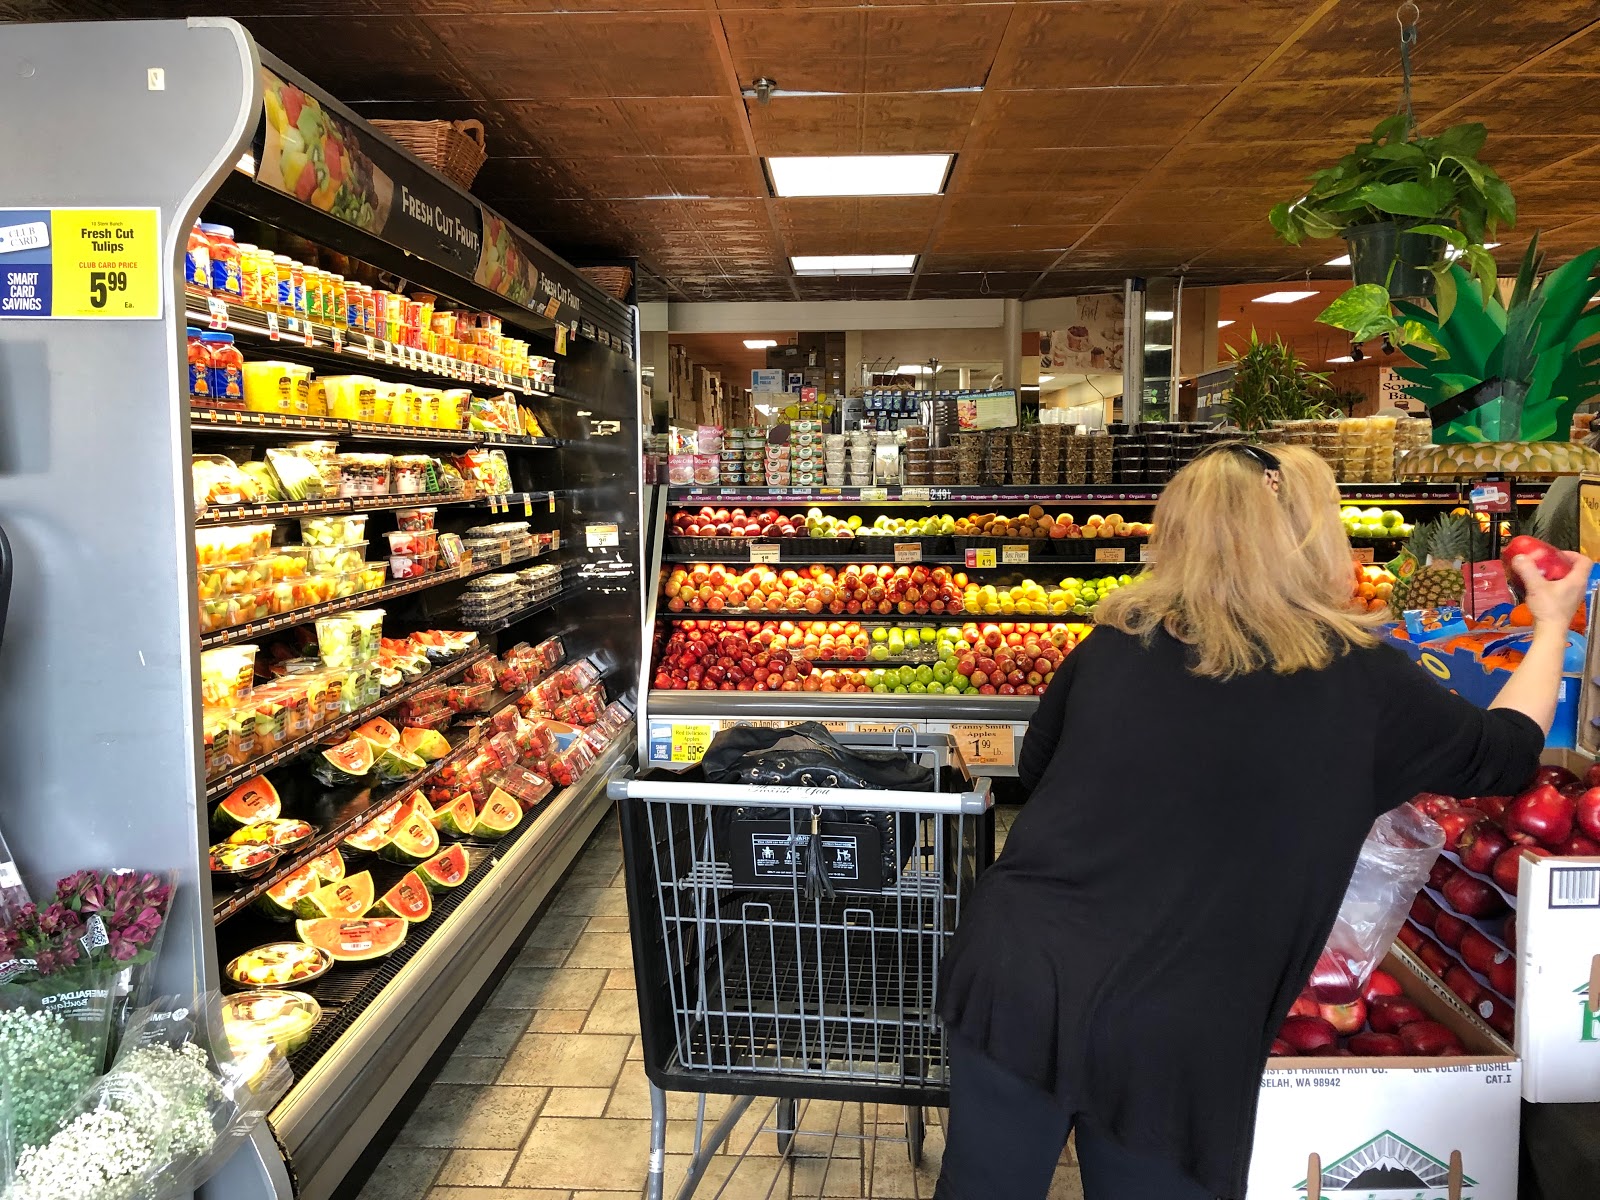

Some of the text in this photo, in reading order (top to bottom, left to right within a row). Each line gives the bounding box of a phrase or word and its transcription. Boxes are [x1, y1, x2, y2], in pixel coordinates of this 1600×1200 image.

[81, 228, 134, 239] Fresh Cut
[92, 241, 124, 254] Tulips
[7, 272, 38, 286] SMART
[10, 286, 35, 298] CARD
[2, 298, 42, 310] SAVINGS
[1260, 1078, 1340, 1088] SELAH, WA 98942
